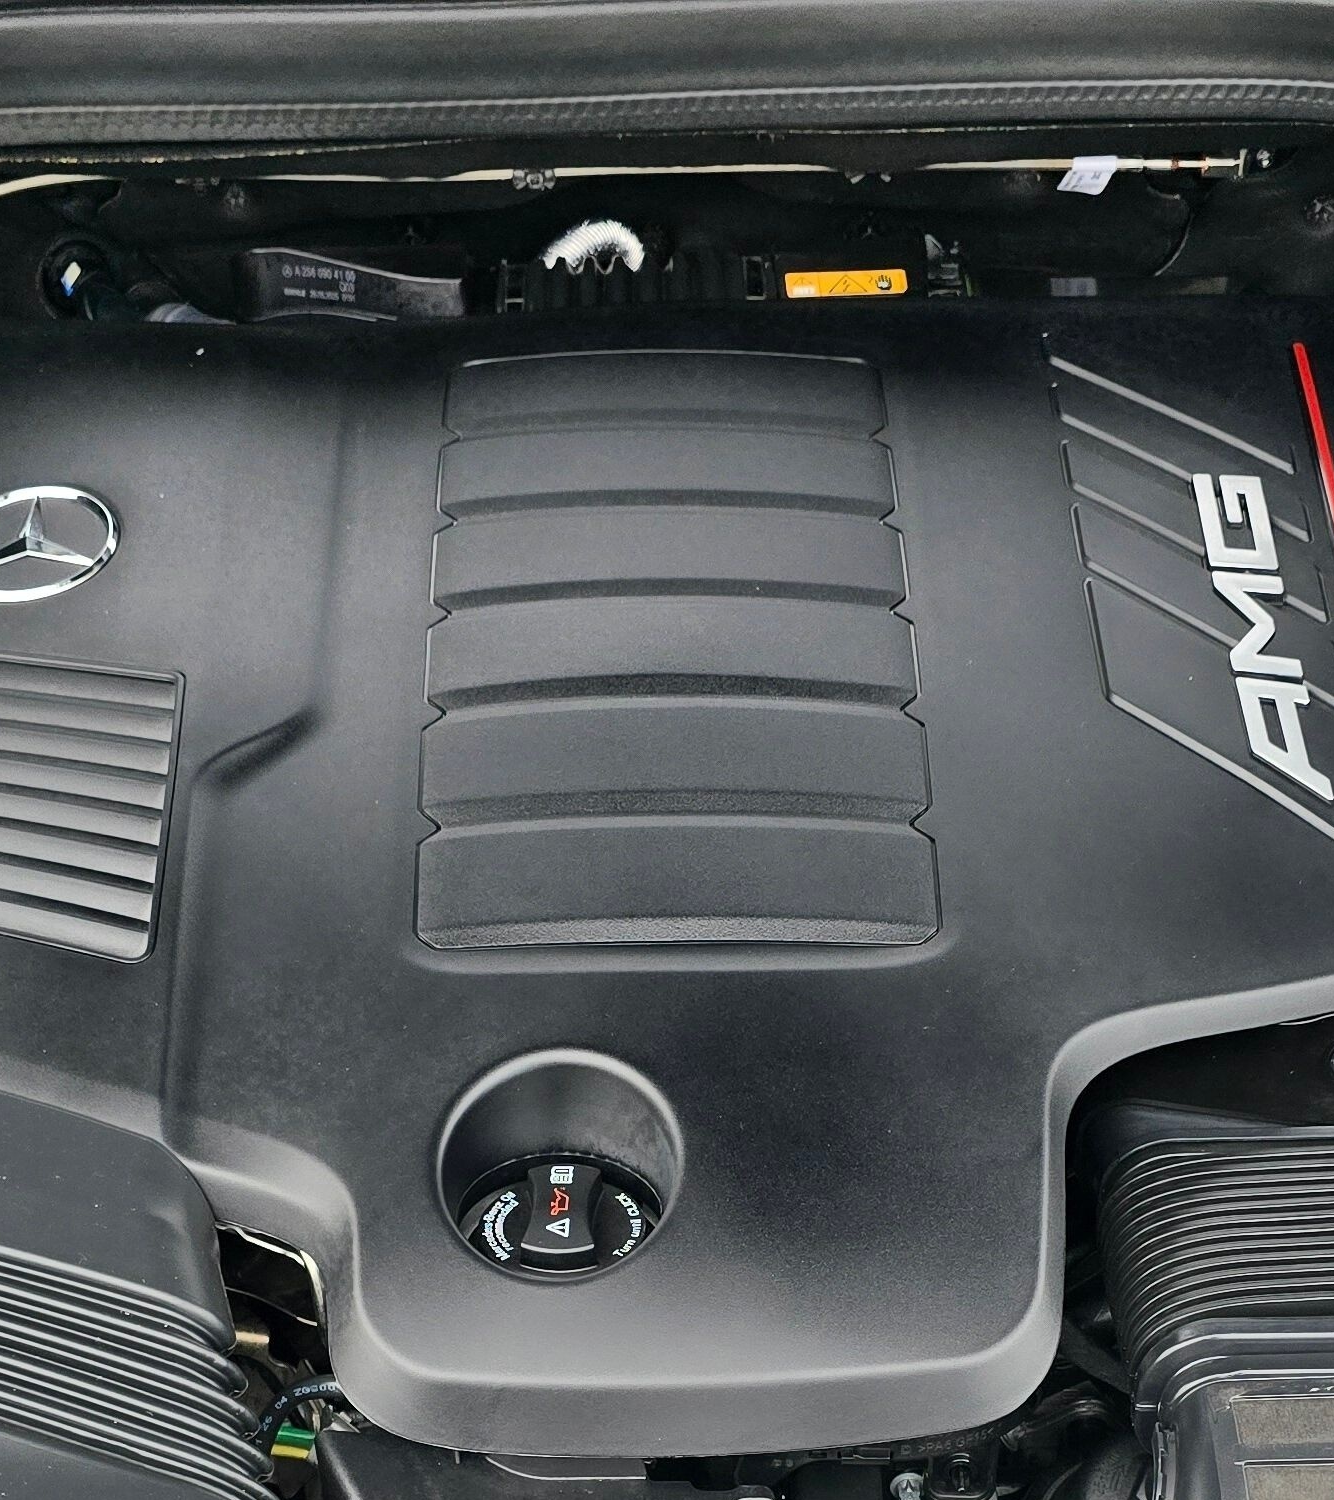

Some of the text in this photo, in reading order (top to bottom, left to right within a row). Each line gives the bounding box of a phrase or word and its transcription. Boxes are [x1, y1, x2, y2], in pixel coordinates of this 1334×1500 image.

[1192, 472, 1334, 801] AMG
[482, 1201, 510, 1260] Mercedes-Benz
[495, 1199, 519, 1251] recommended
[612, 1192, 641, 1257] Turn until CLICK
